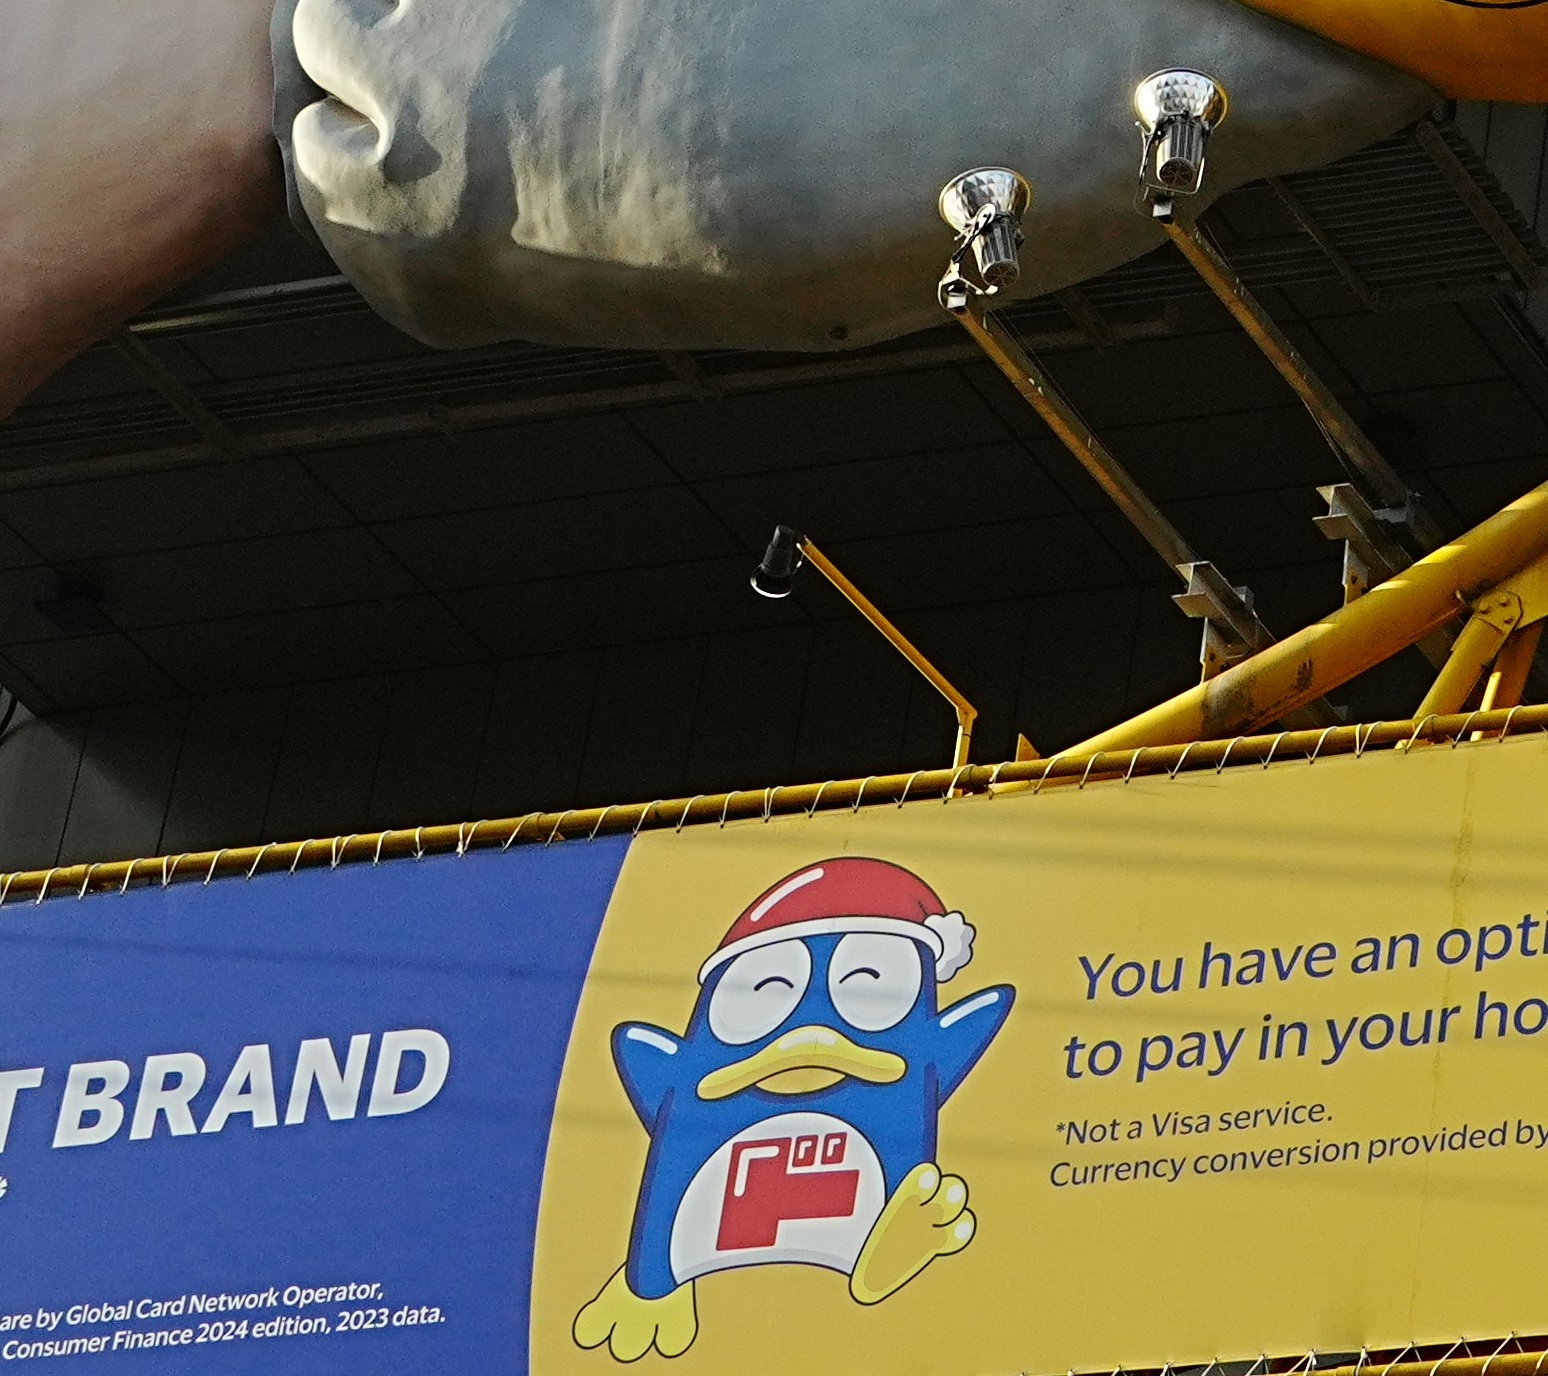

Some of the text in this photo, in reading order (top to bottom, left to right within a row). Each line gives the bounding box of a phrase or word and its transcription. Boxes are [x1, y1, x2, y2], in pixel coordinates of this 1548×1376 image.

[1077, 953, 1184, 1000] You
[1197, 941, 1337, 990] have
[1350, 931, 1421, 976] an
[1062, 1035, 1123, 1079] to
[1135, 1026, 1246, 1083] pay
[1257, 1013, 1309, 1061] in
[1320, 1004, 1461, 1066] your
[51, 1028, 451, 1150] BRAND
[1126, 1120, 1143, 1140] a
[1152, 1112, 1211, 1137] Visa
[1218, 1101, 1333, 1132] service.
[1049, 1156, 1187, 1188] Currency
[1192, 1138, 1360, 1175] conversion
[1367, 1120, 1508, 1164] provided
[2, 1334, 108, 1362] Consumer
[112, 1328, 194, 1350] Finance
[195, 1320, 249, 1344] 2024
[252, 1315, 333, 1340] edition,
[335, 1307, 389, 1333] 2023
[391, 1303, 447, 1327] data.
[36, 1307, 63, 1330] by
[65, 1299, 133, 1326] Global
[135, 1295, 187, 1320] Card
[187, 1287, 280, 1315] Network
[281, 1280, 385, 1312] Operator,
